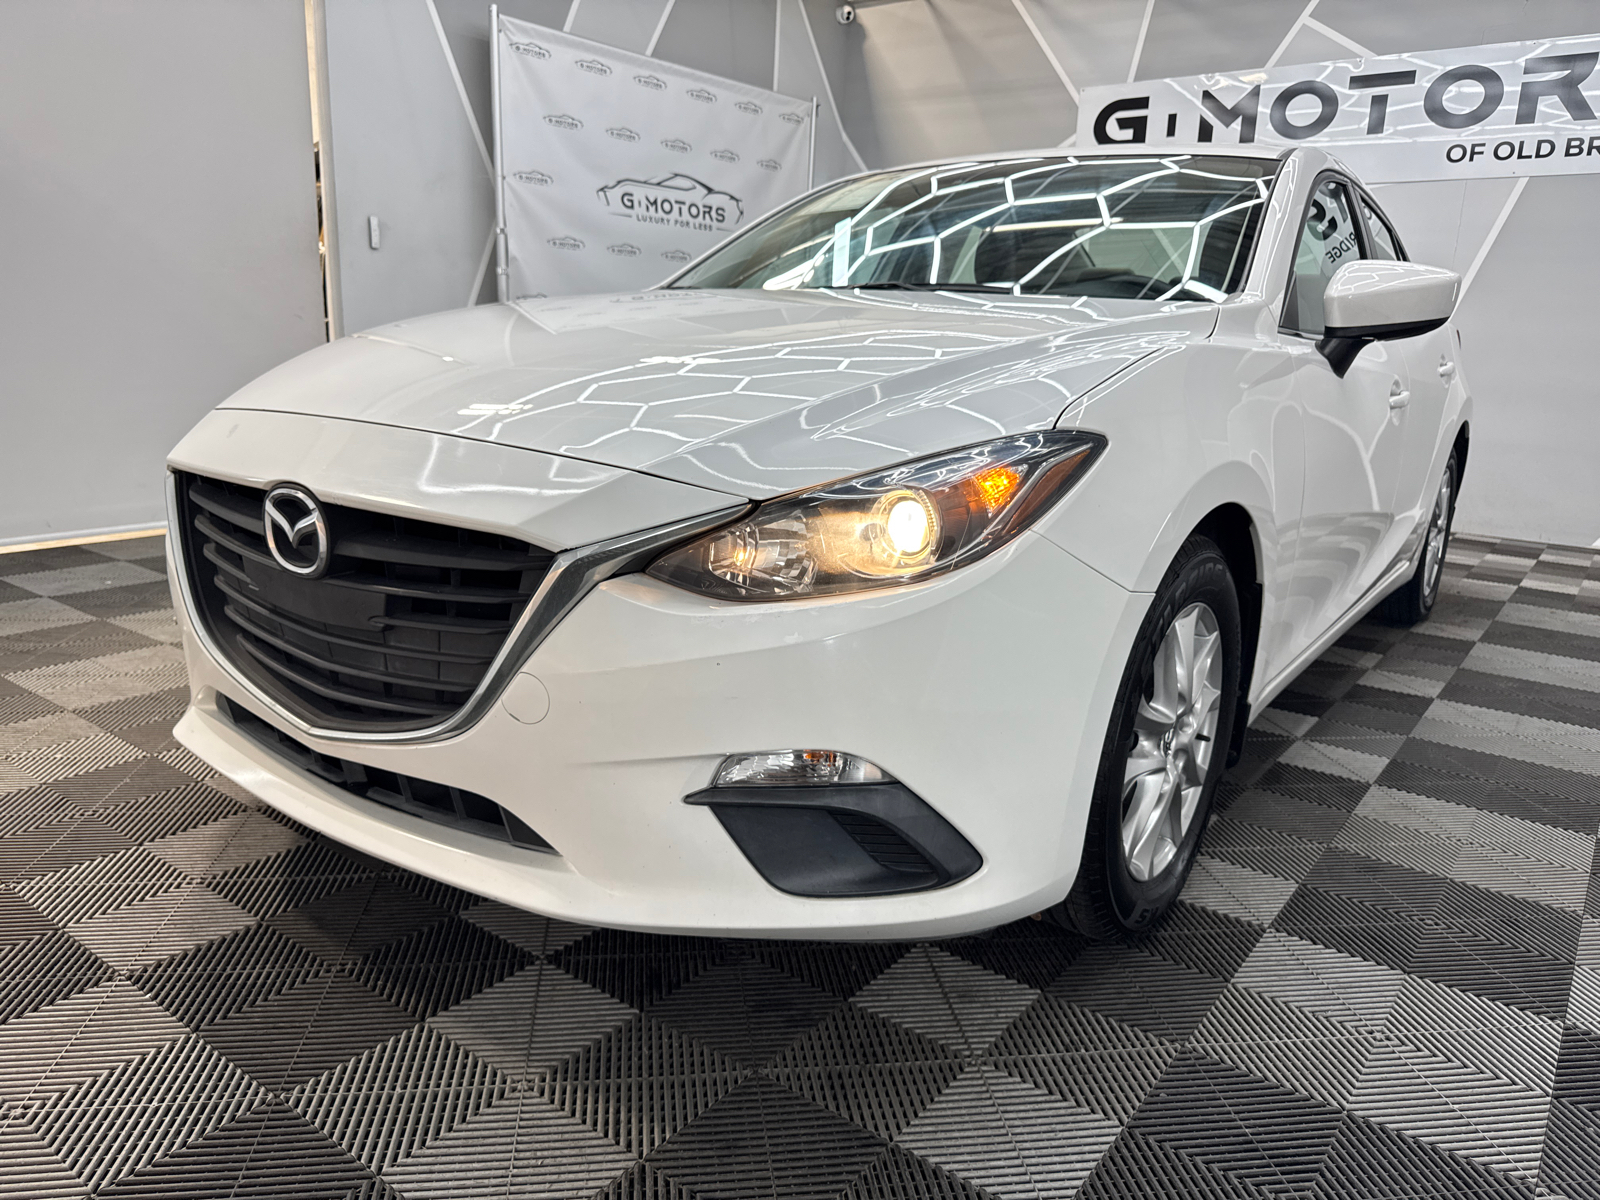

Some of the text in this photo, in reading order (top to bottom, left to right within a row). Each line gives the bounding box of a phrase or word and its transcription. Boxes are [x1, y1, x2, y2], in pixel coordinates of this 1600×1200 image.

[1445, 143, 1486, 163] OF
[1493, 139, 1556, 161] OLD
[635, 214, 714, 232] LUXURY FOR LESS
